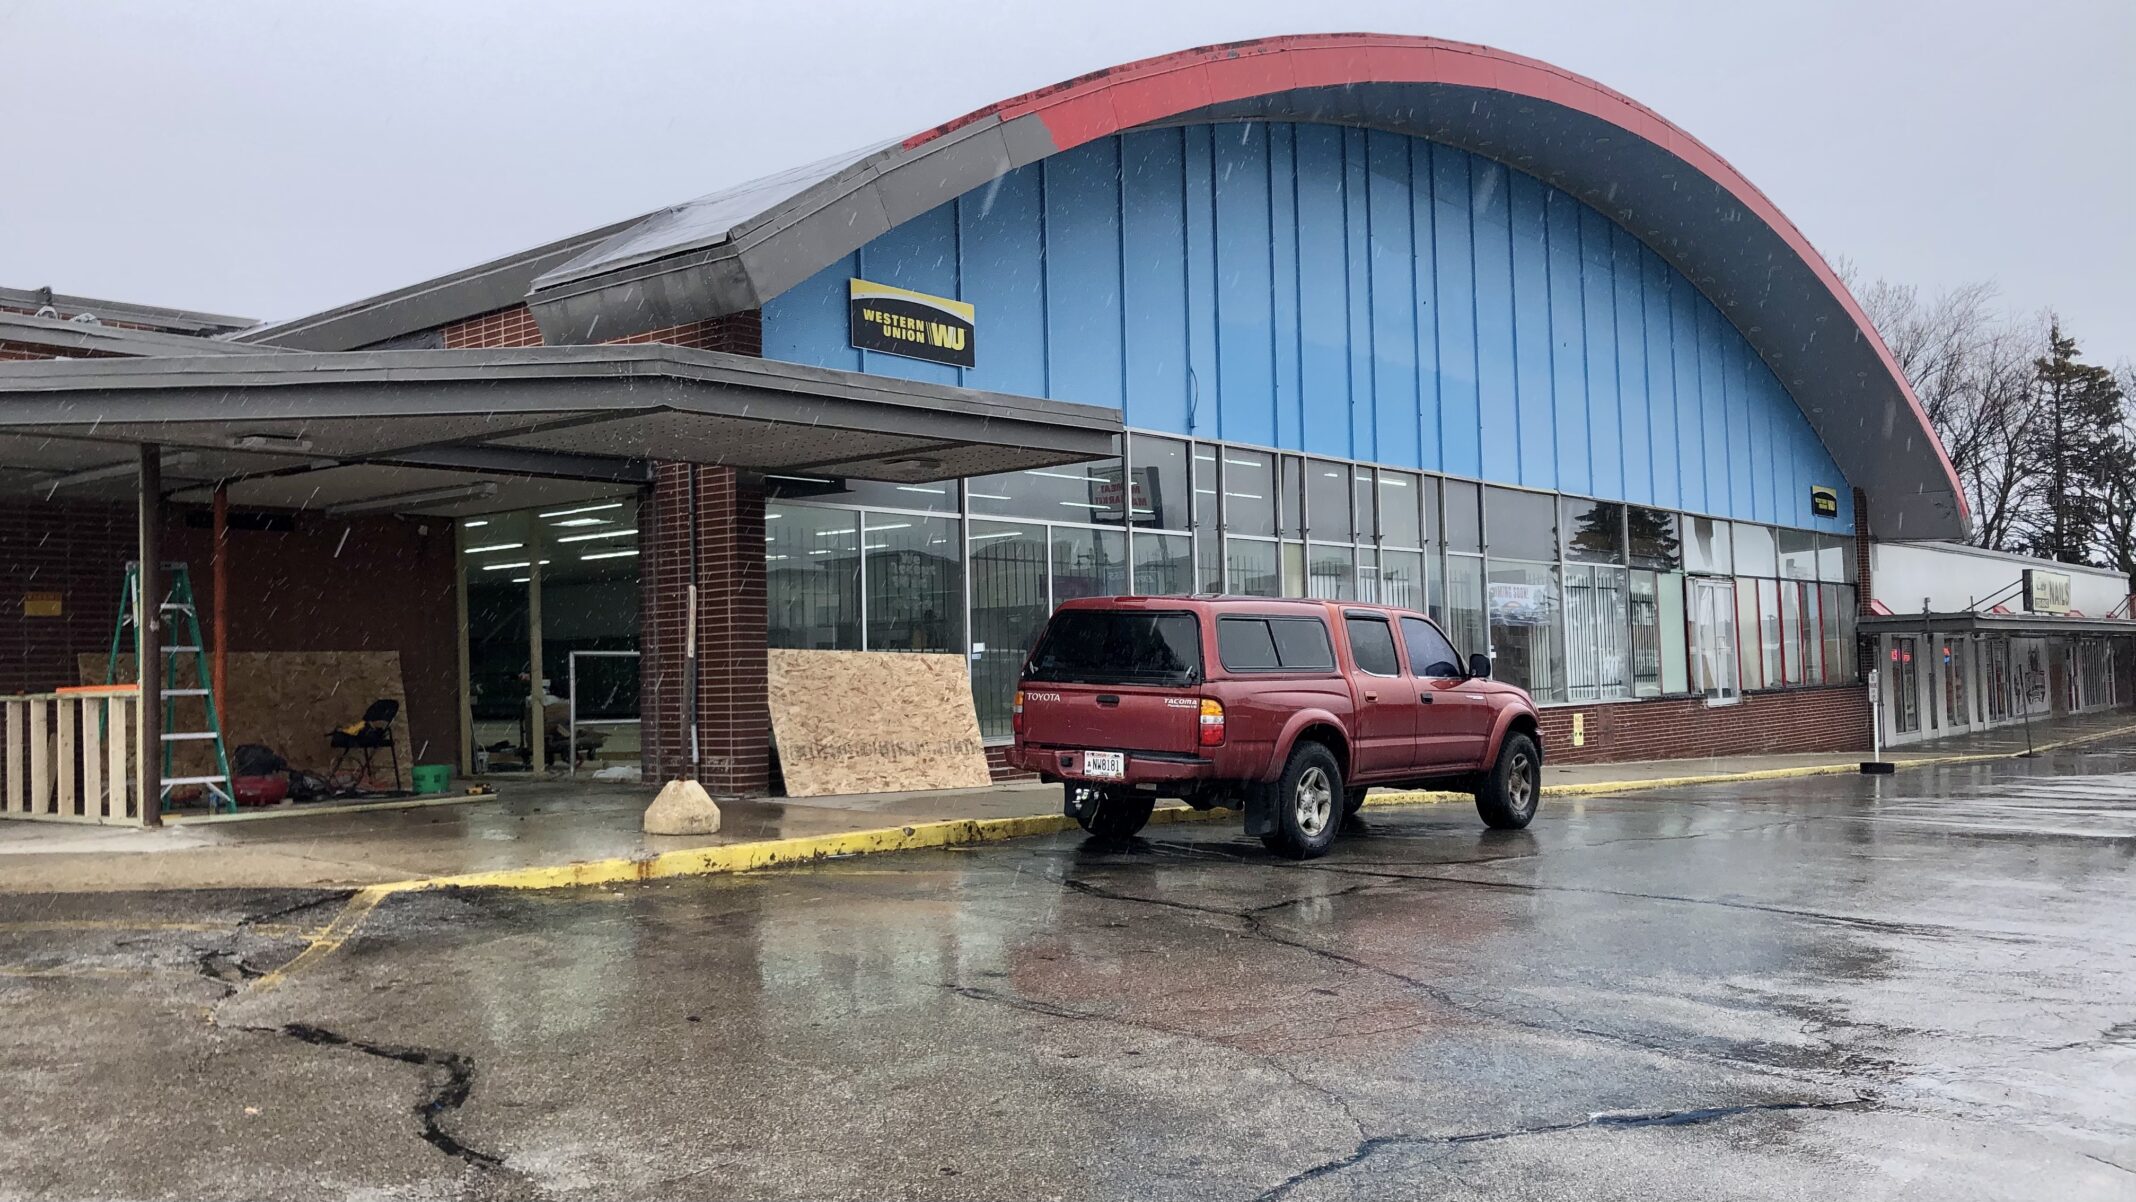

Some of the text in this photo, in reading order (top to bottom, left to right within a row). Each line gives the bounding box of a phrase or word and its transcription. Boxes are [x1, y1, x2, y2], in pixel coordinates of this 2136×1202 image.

[863, 308, 925, 331] WESTERN
[883, 326, 925, 343] UNION
[930, 322, 966, 351] WU
[2049, 580, 2070, 606] NAILS
[1027, 692, 1061, 702] TOYOTA
[1092, 758, 1120, 772] NW8181
